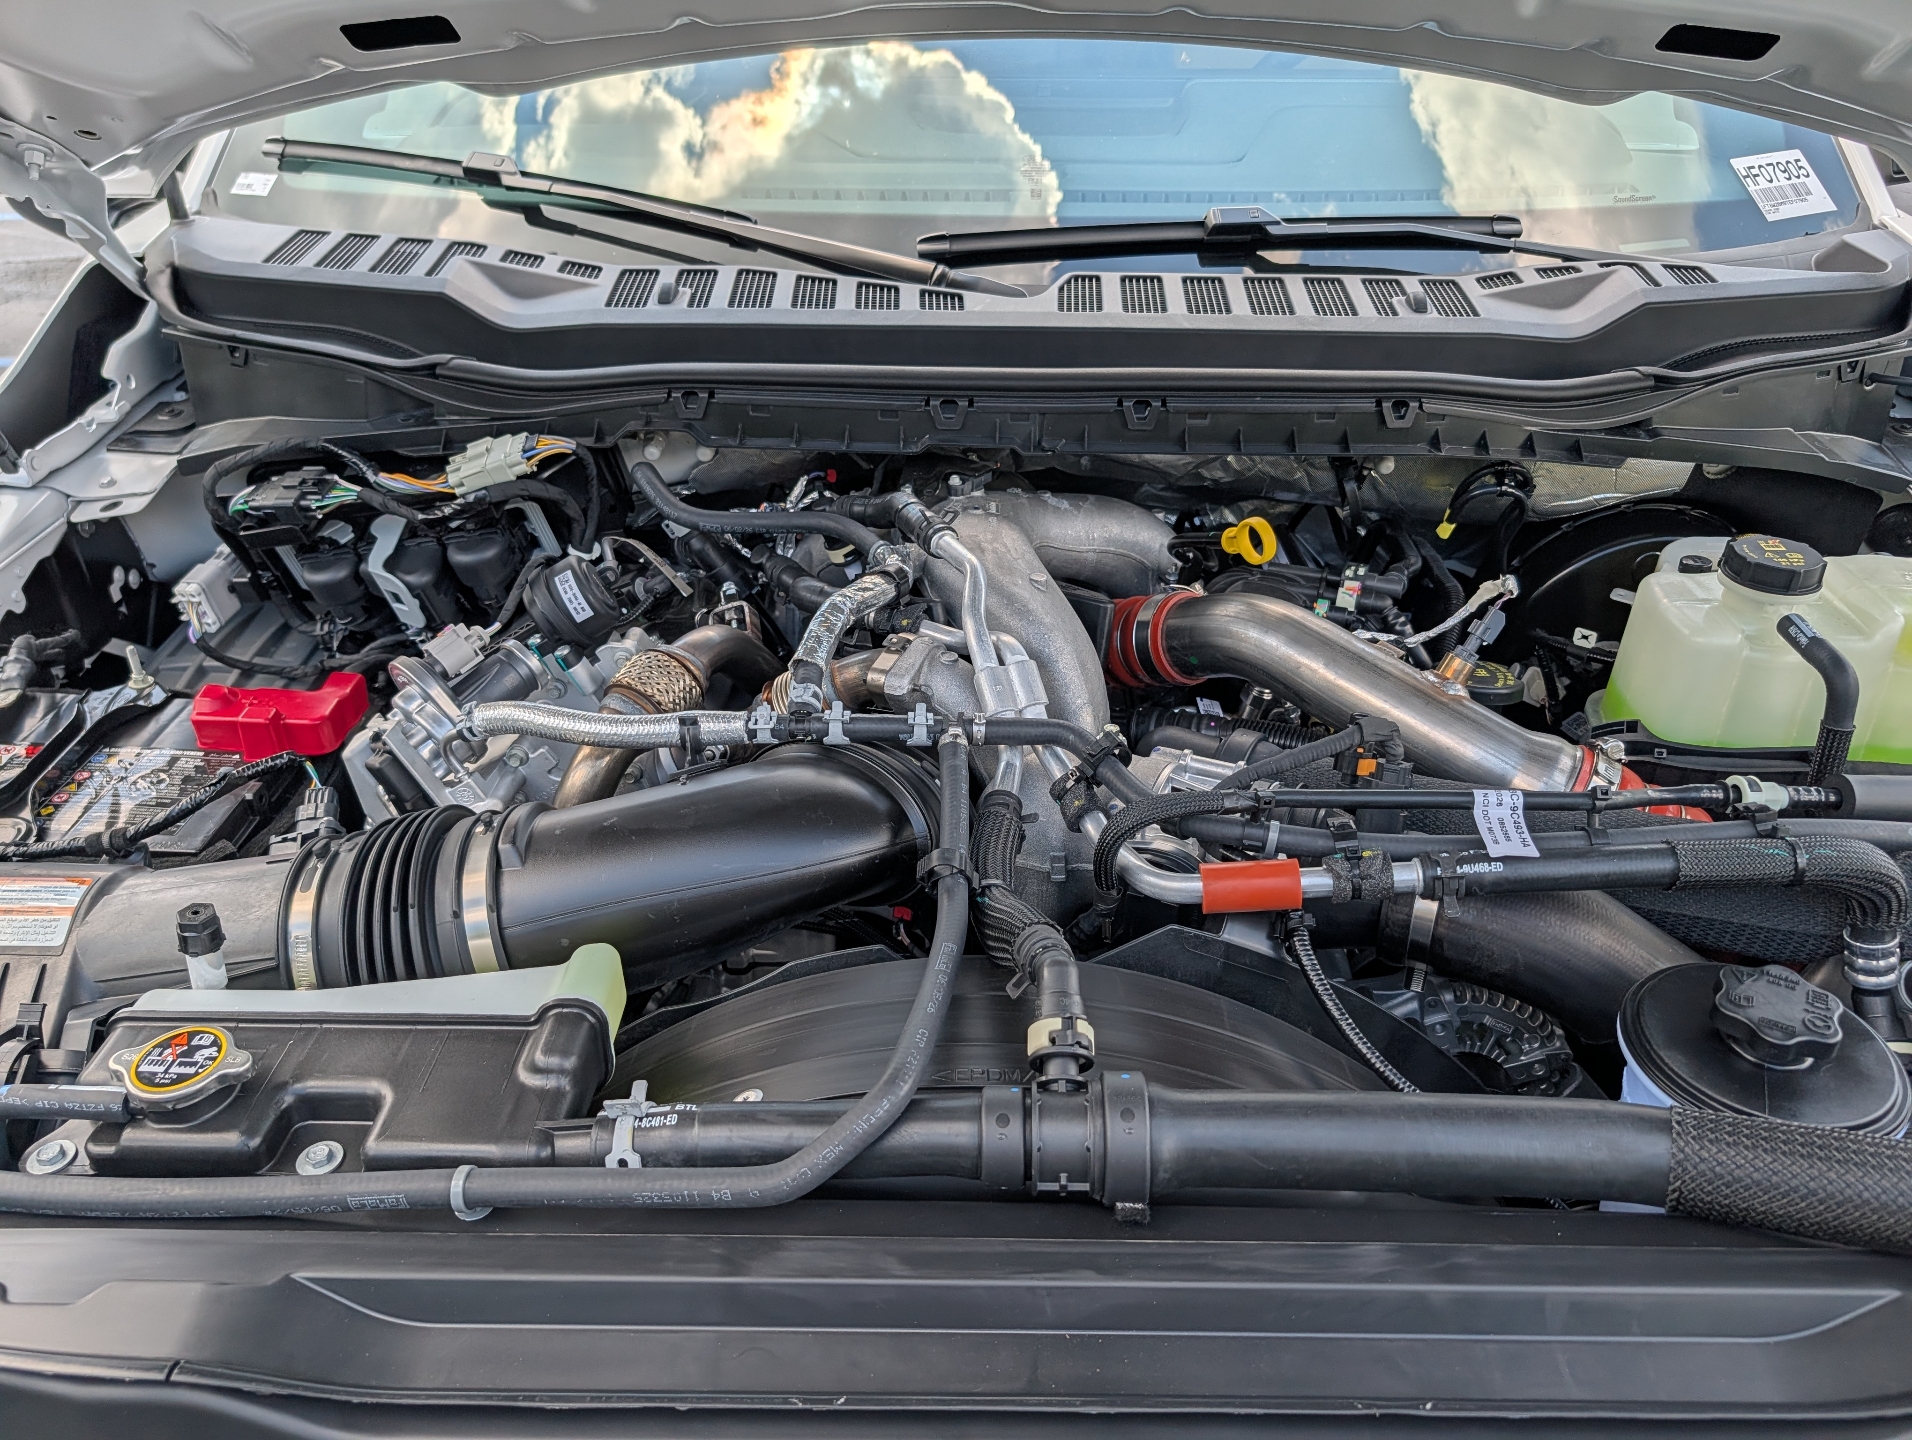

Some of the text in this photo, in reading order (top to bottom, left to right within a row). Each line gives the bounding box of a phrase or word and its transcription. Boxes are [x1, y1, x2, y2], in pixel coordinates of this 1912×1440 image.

[1736, 158, 1811, 188] HF07905
[1482, 810, 1492, 825] DOT
[35, 1100, 60, 1109] CIP
[814, 1141, 844, 1168] MEX
[711, 1189, 732, 1201] B4
